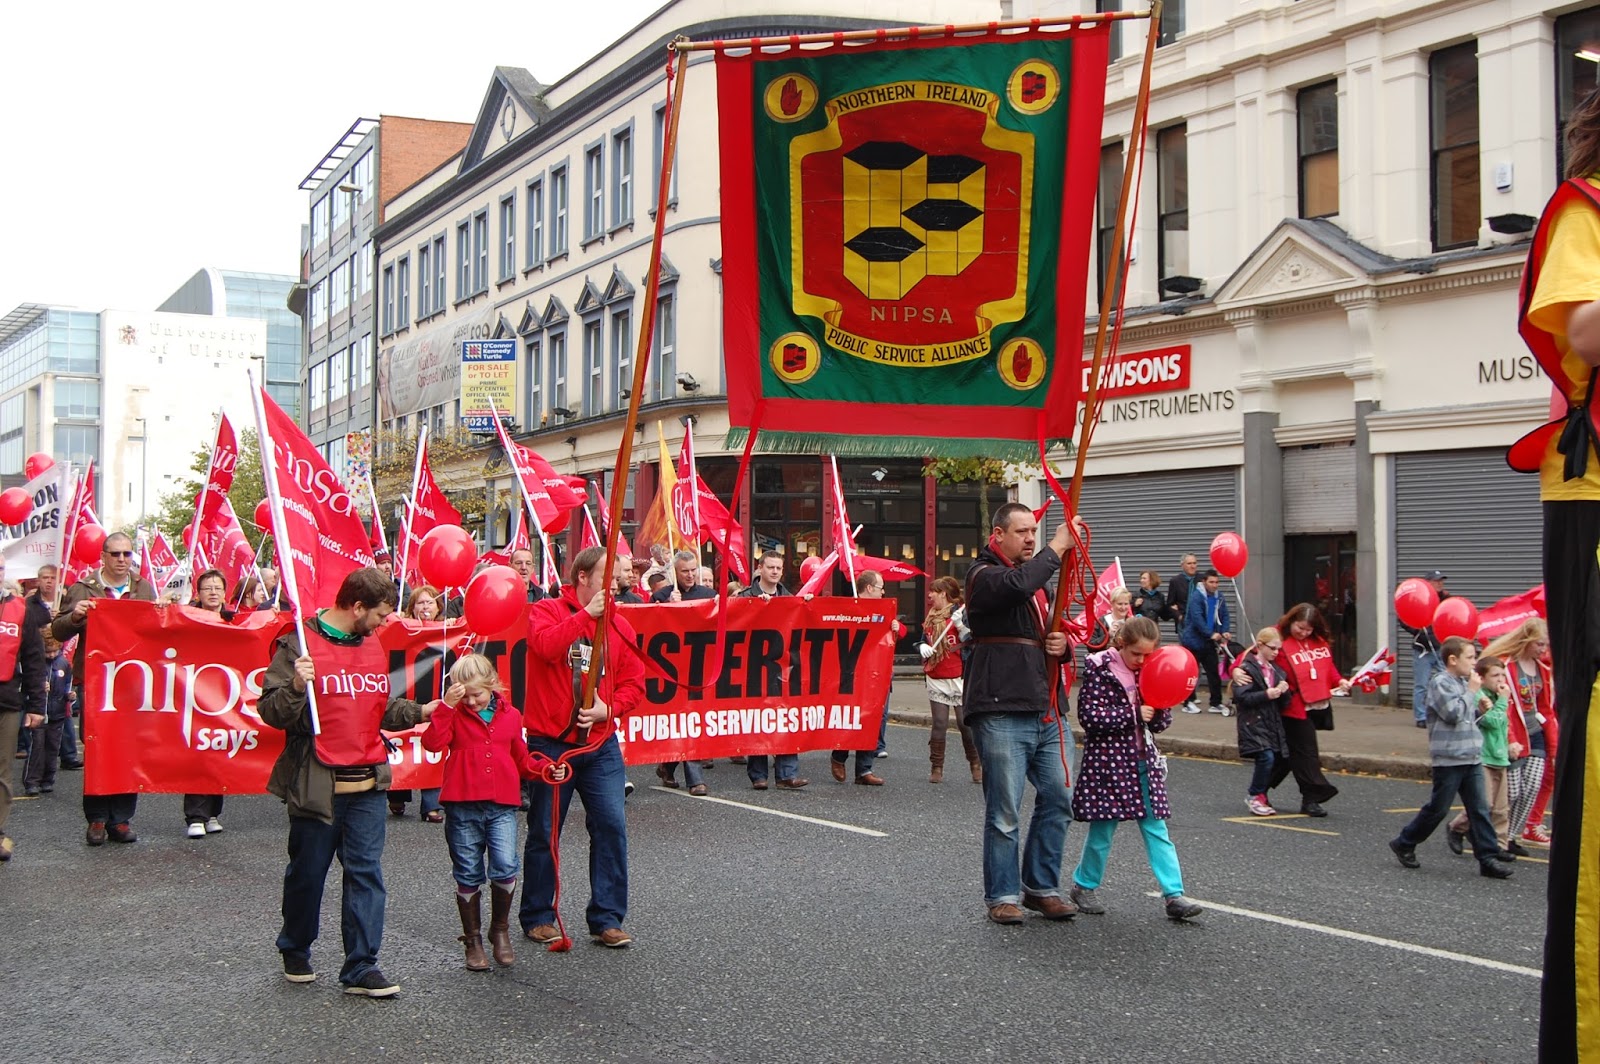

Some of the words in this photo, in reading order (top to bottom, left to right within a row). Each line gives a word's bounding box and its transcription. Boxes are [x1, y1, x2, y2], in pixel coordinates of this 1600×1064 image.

[837, 84, 916, 112] NORTHERN
[926, 84, 988, 109] IRELAND
[870, 305, 954, 324] NIPSA
[149, 322, 258, 345] University
[827, 328, 868, 355] PUBLIC
[873, 343, 926, 363] SERVICE
[930, 336, 989, 363] ALLIANCE
[1478, 355, 1540, 384] MUSI
[1112, 389, 1234, 422] INSTRUMENTS
[25, 541, 57, 557] nips
[637, 628, 869, 705] STERITY
[1291, 645, 1331, 665] nipsa
[101, 647, 271, 749] nips
[321, 668, 388, 701] nipsa
[628, 711, 702, 743] PUBLIC
[704, 707, 800, 738] SERVICES
[801, 704, 825, 732] FOR
[828, 705, 863, 731] ALL
[196, 727, 259, 759] says
